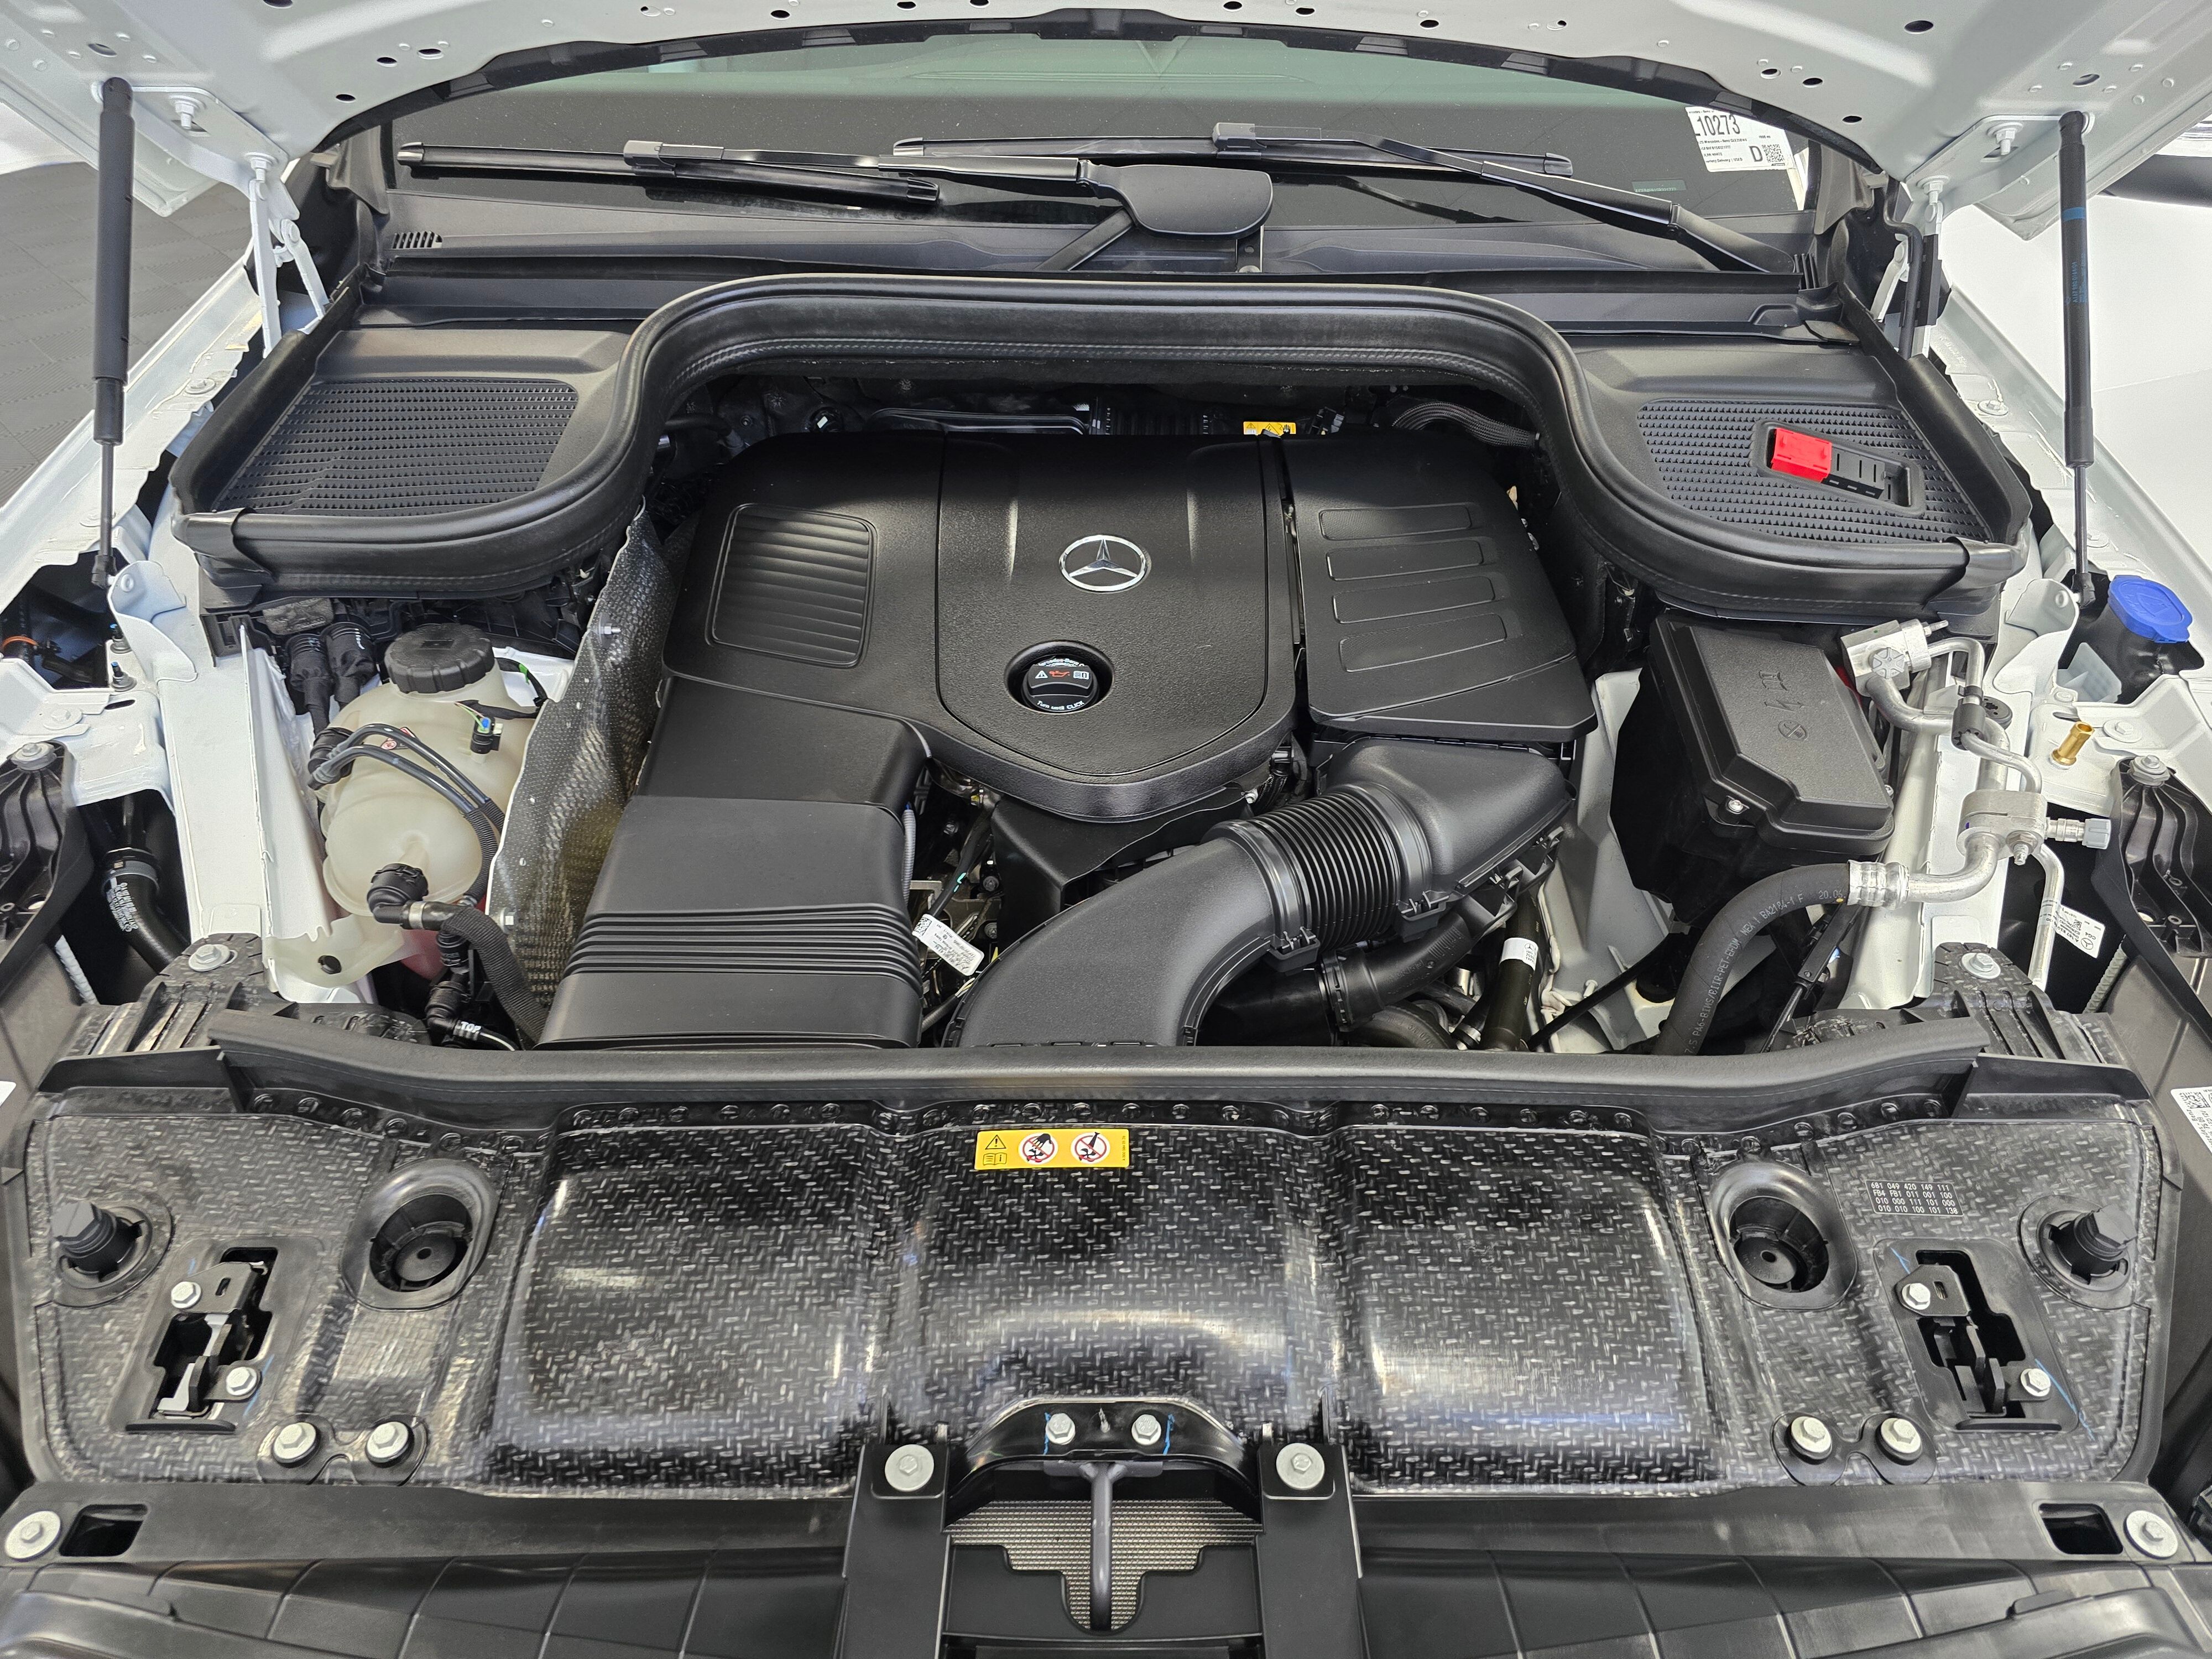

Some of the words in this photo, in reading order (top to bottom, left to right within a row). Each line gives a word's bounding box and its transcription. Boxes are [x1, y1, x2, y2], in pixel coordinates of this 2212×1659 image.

[1749, 145, 1763, 162] D
[1037, 700, 1050, 708] Turn
[1066, 700, 1084, 709] CLICK
[461, 1021, 482, 1033] TOP
